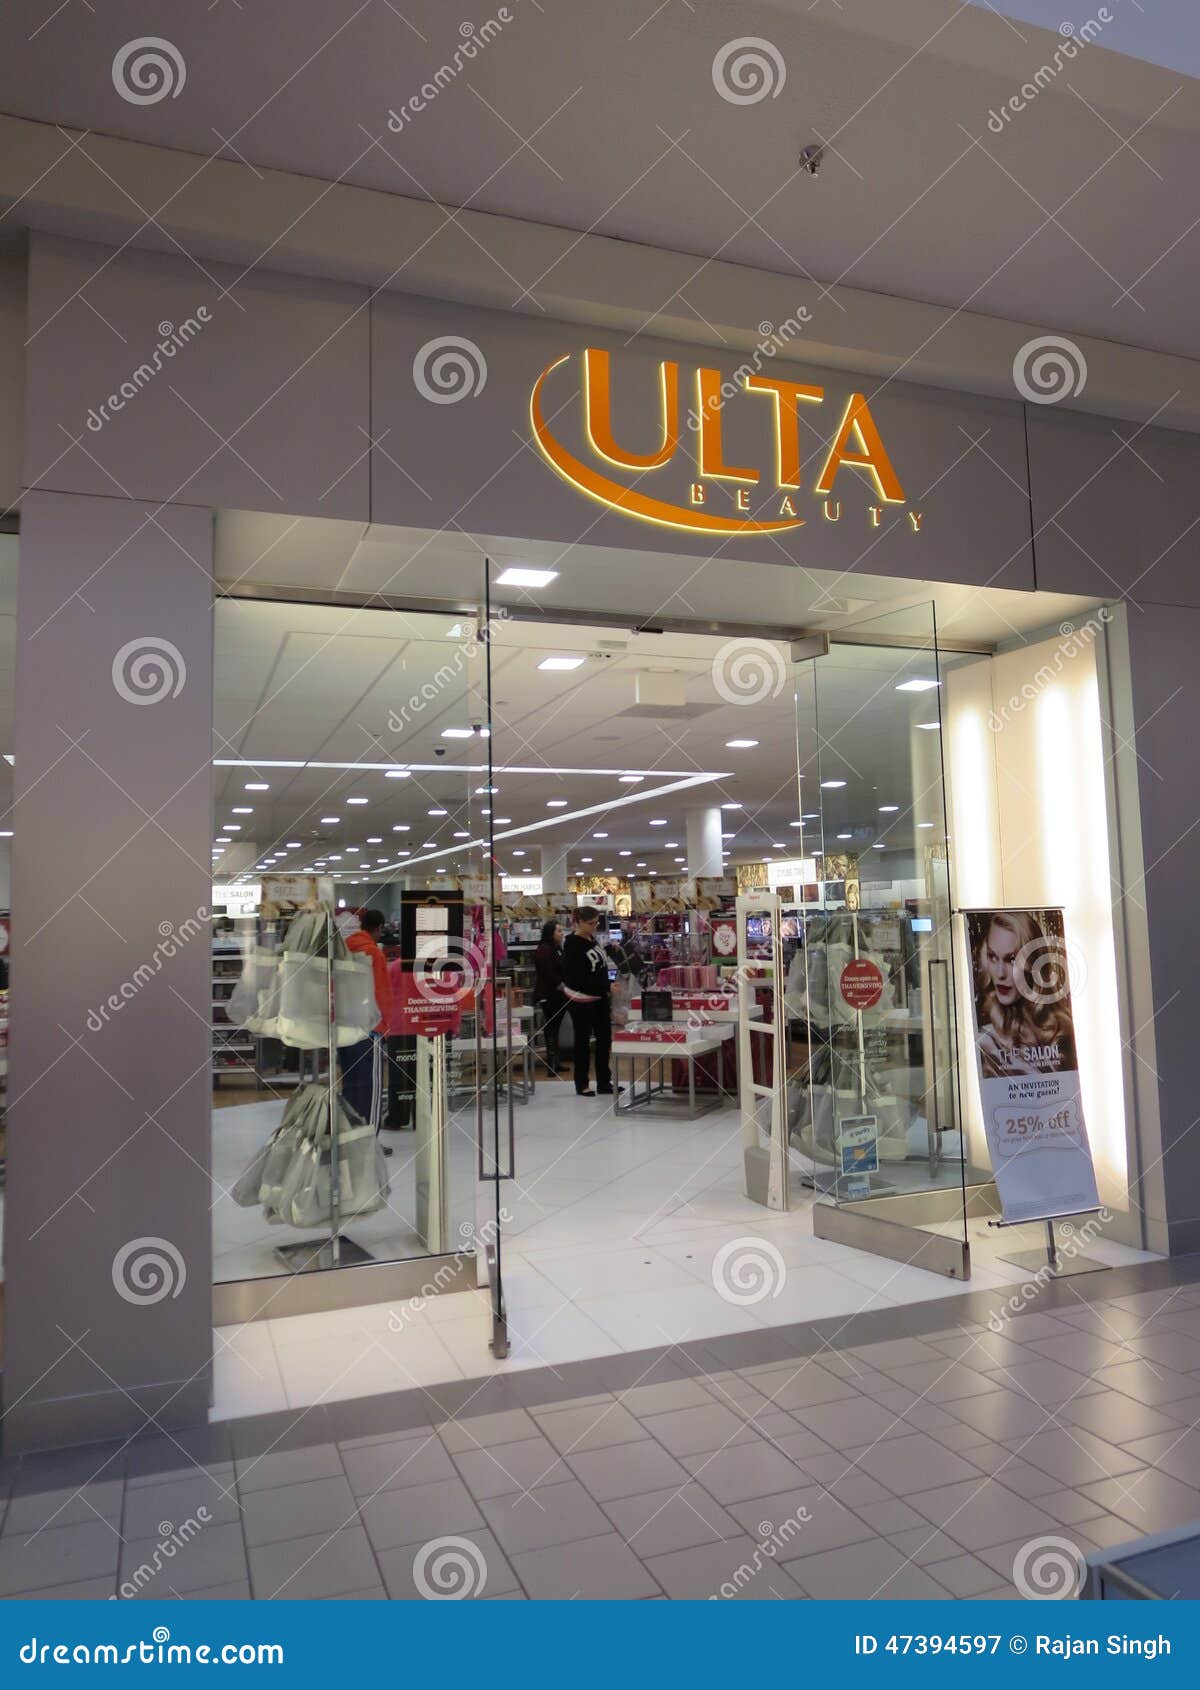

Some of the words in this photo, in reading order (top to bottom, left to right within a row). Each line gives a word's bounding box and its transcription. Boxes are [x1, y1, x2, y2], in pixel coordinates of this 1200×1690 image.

[584, 347, 906, 504] ULTA
[690, 483, 924, 532] BEAUTY
[403, 1004, 458, 1014] THANKSGIVING
[396, 1053, 416, 1062] mond
[1023, 1043, 1060, 1061] SALON
[1008, 1084, 1019, 1092] AN
[1021, 1079, 1060, 1090] INVITATION
[1008, 1091, 1017, 1100] to
[1018, 1089, 1035, 1098] new
[1005, 1115, 1045, 1135] 25%
[1048, 1110, 1071, 1130] off
